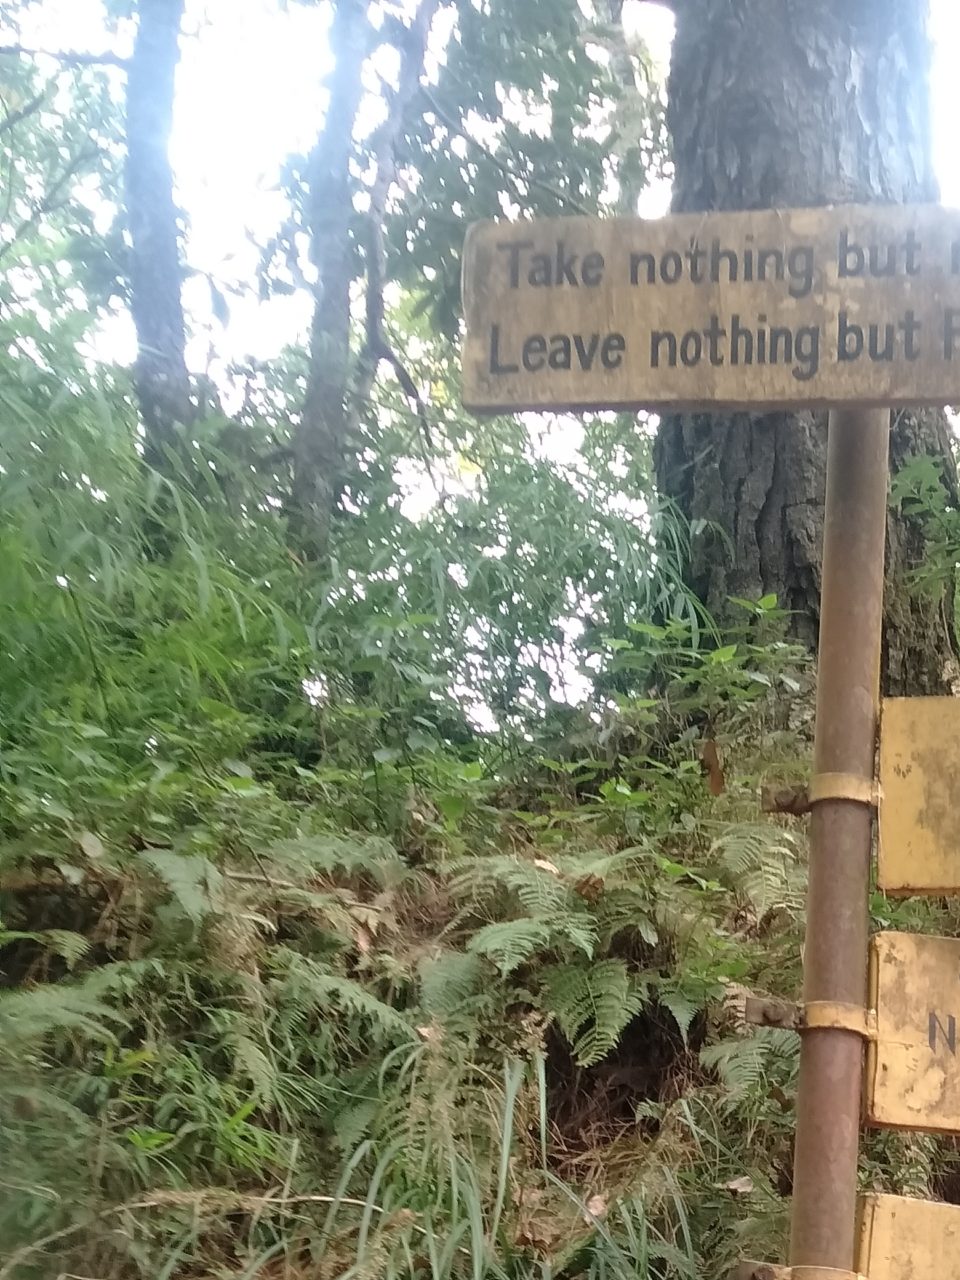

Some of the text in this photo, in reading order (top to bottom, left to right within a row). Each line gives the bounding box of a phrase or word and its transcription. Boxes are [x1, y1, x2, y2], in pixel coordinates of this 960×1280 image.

[498, 240, 603, 289] Take
[629, 236, 814, 298] nothing
[838, 230, 922, 278] but
[490, 324, 624, 376] Leave
[650, 313, 819, 380] nothing
[838, 310, 923, 363] but
